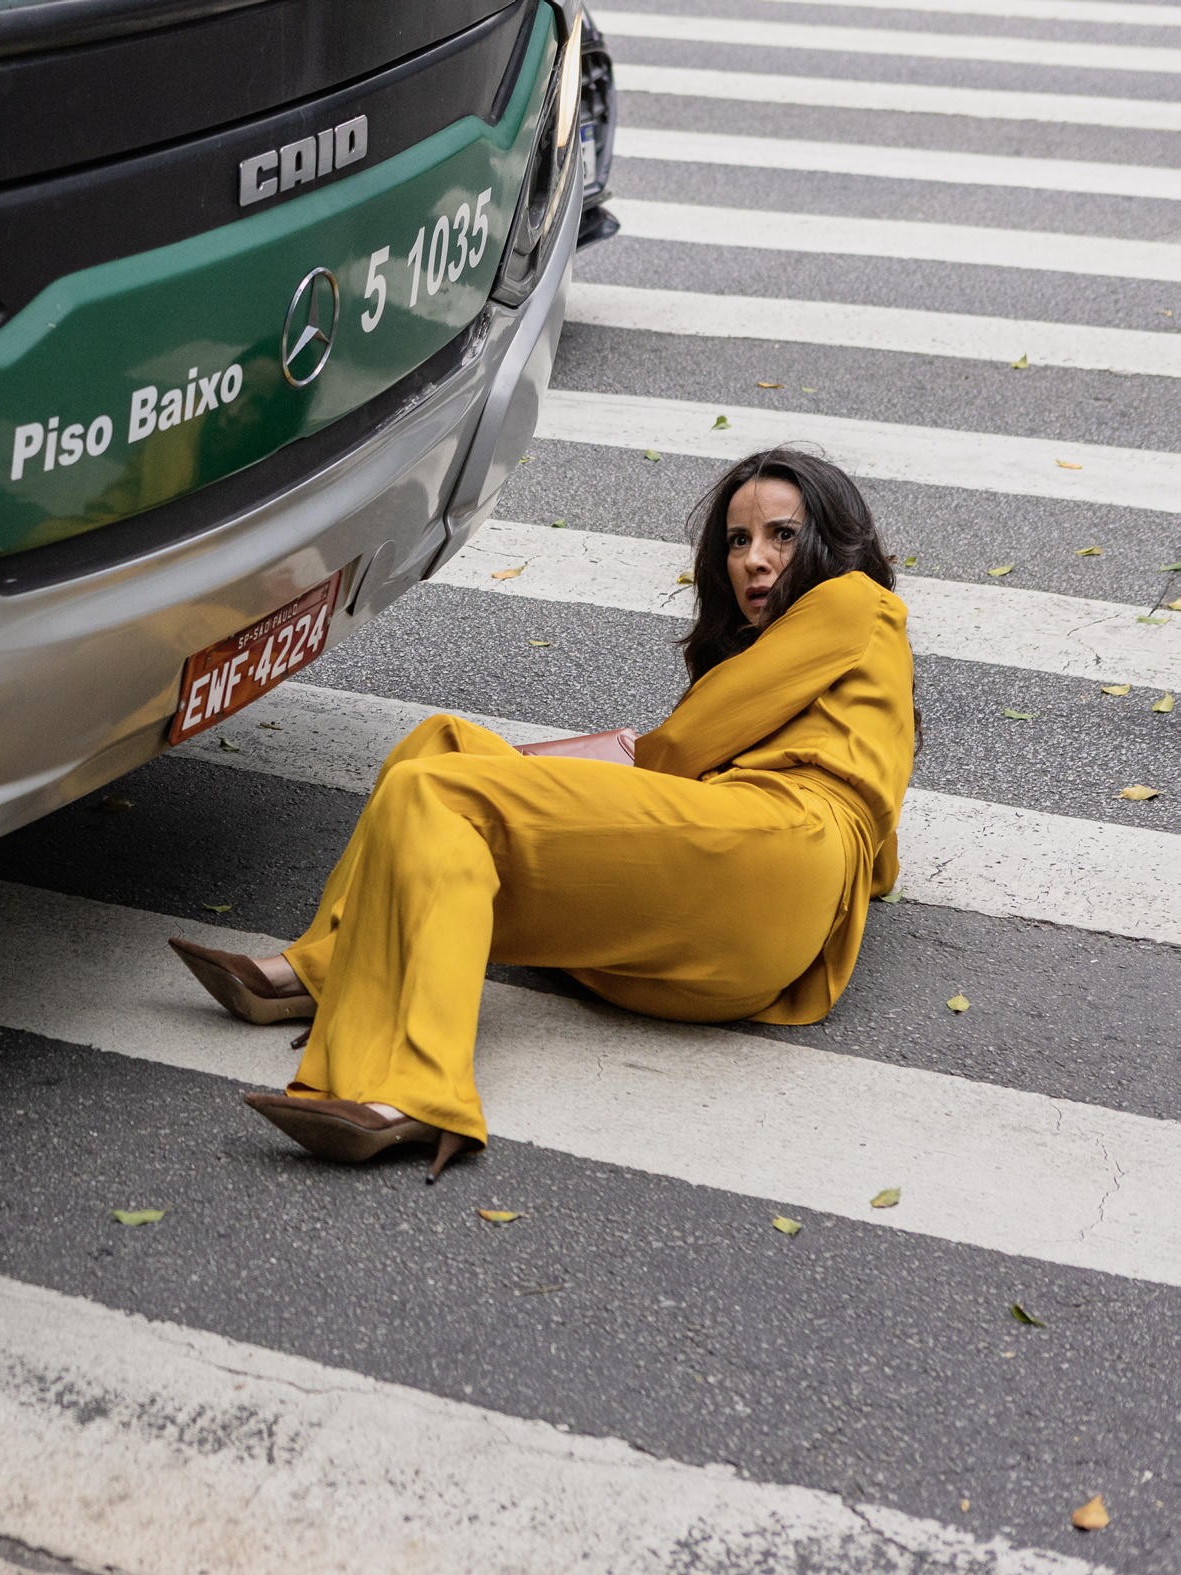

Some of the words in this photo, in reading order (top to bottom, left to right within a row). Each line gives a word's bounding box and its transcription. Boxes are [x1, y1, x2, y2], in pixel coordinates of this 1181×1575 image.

[240, 115, 368, 207] CAIO
[361, 246, 390, 333] 5
[407, 187, 492, 308] 1035
[11, 415, 113, 480] Piso
[128, 364, 243, 443] Baixo
[272, 603, 299, 629] PAULO
